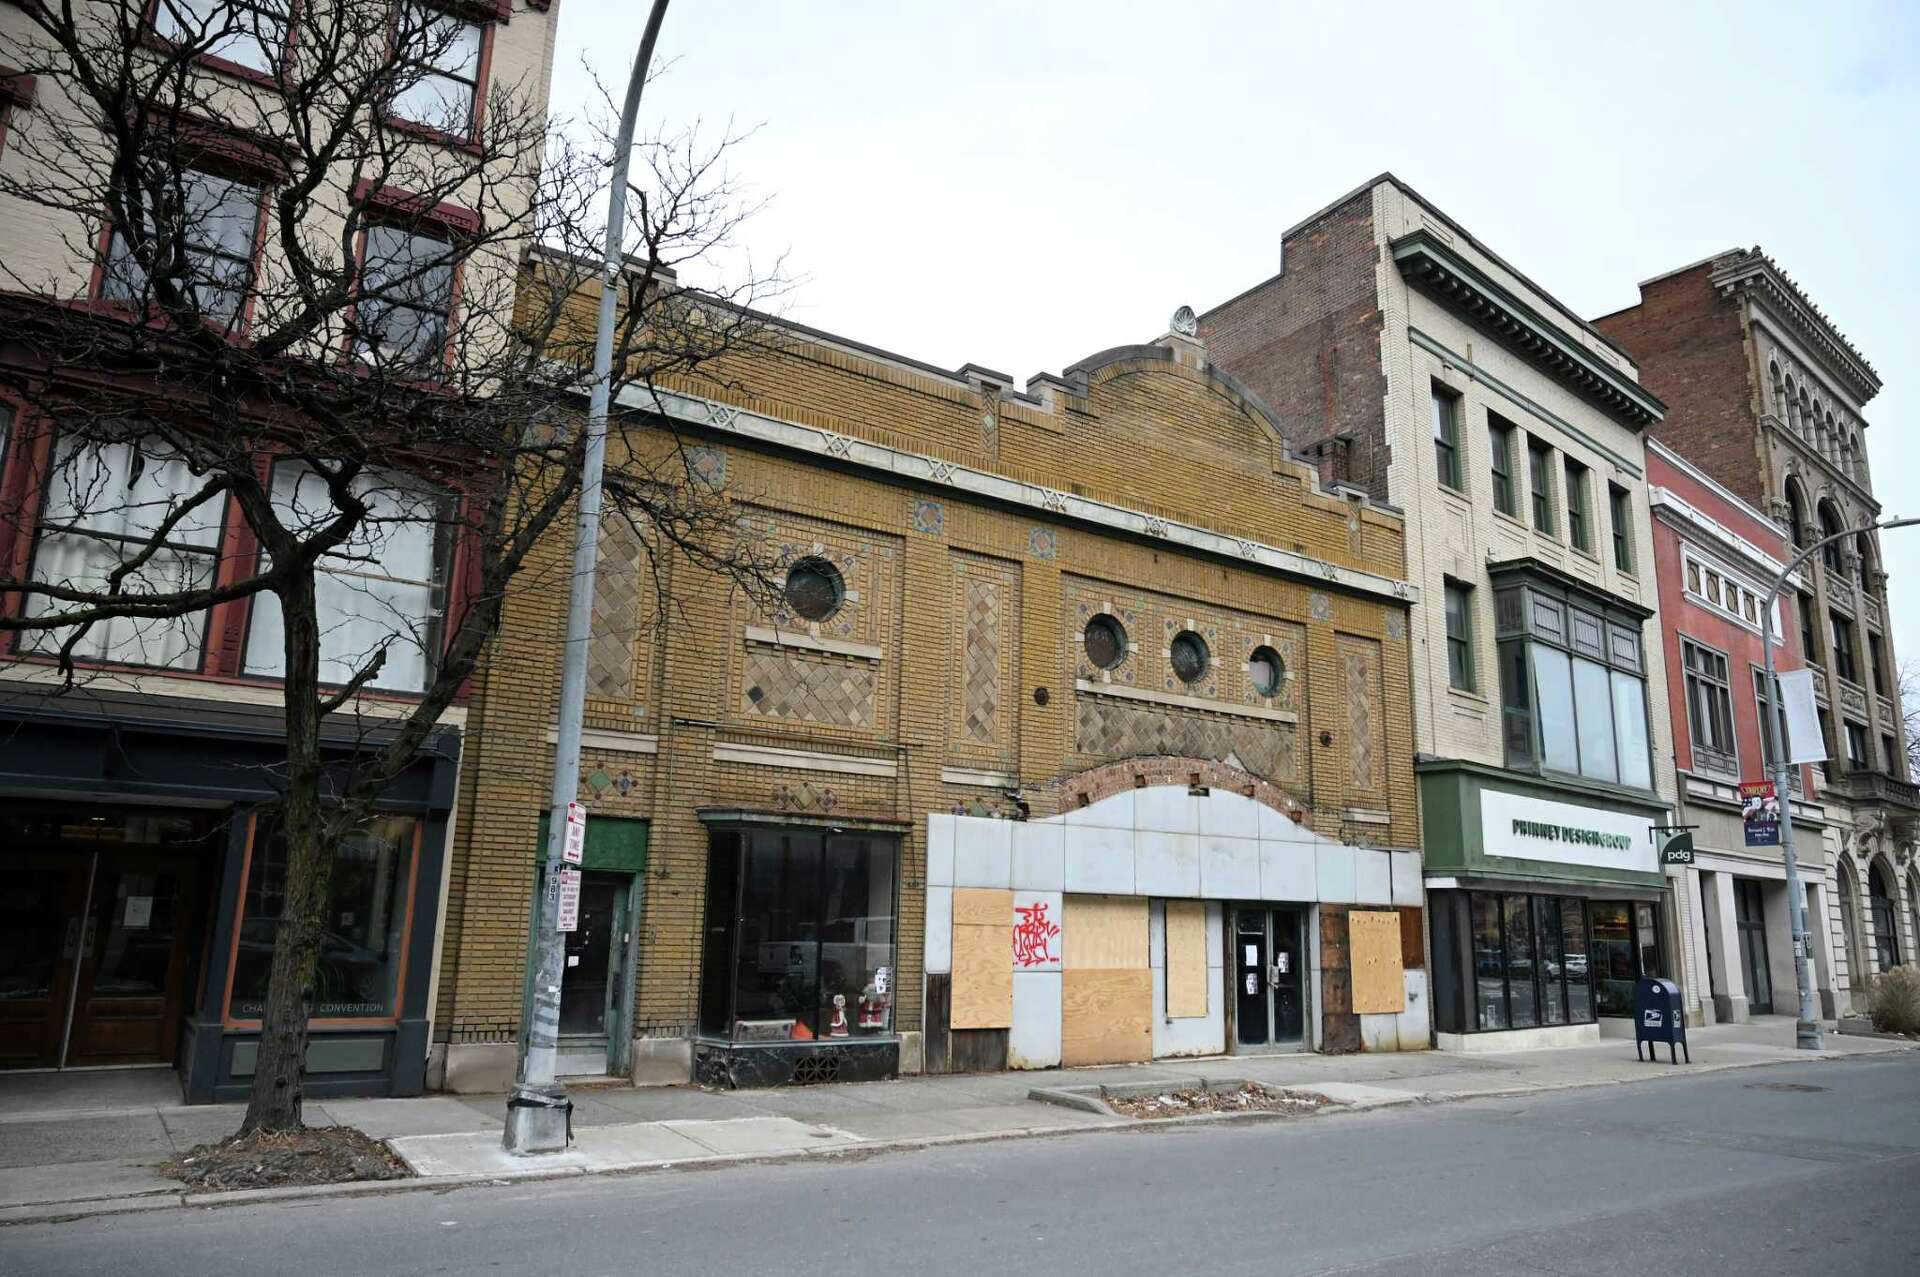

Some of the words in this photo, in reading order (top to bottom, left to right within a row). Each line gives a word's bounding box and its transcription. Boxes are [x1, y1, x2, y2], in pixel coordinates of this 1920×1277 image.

[1512, 819, 1560, 841] PHINNEY
[1562, 826, 1600, 847] DESIGN
[1600, 833, 1631, 851] GROUP
[1667, 849, 1691, 862] pdg
[320, 1003, 384, 1013] CONVENTION
